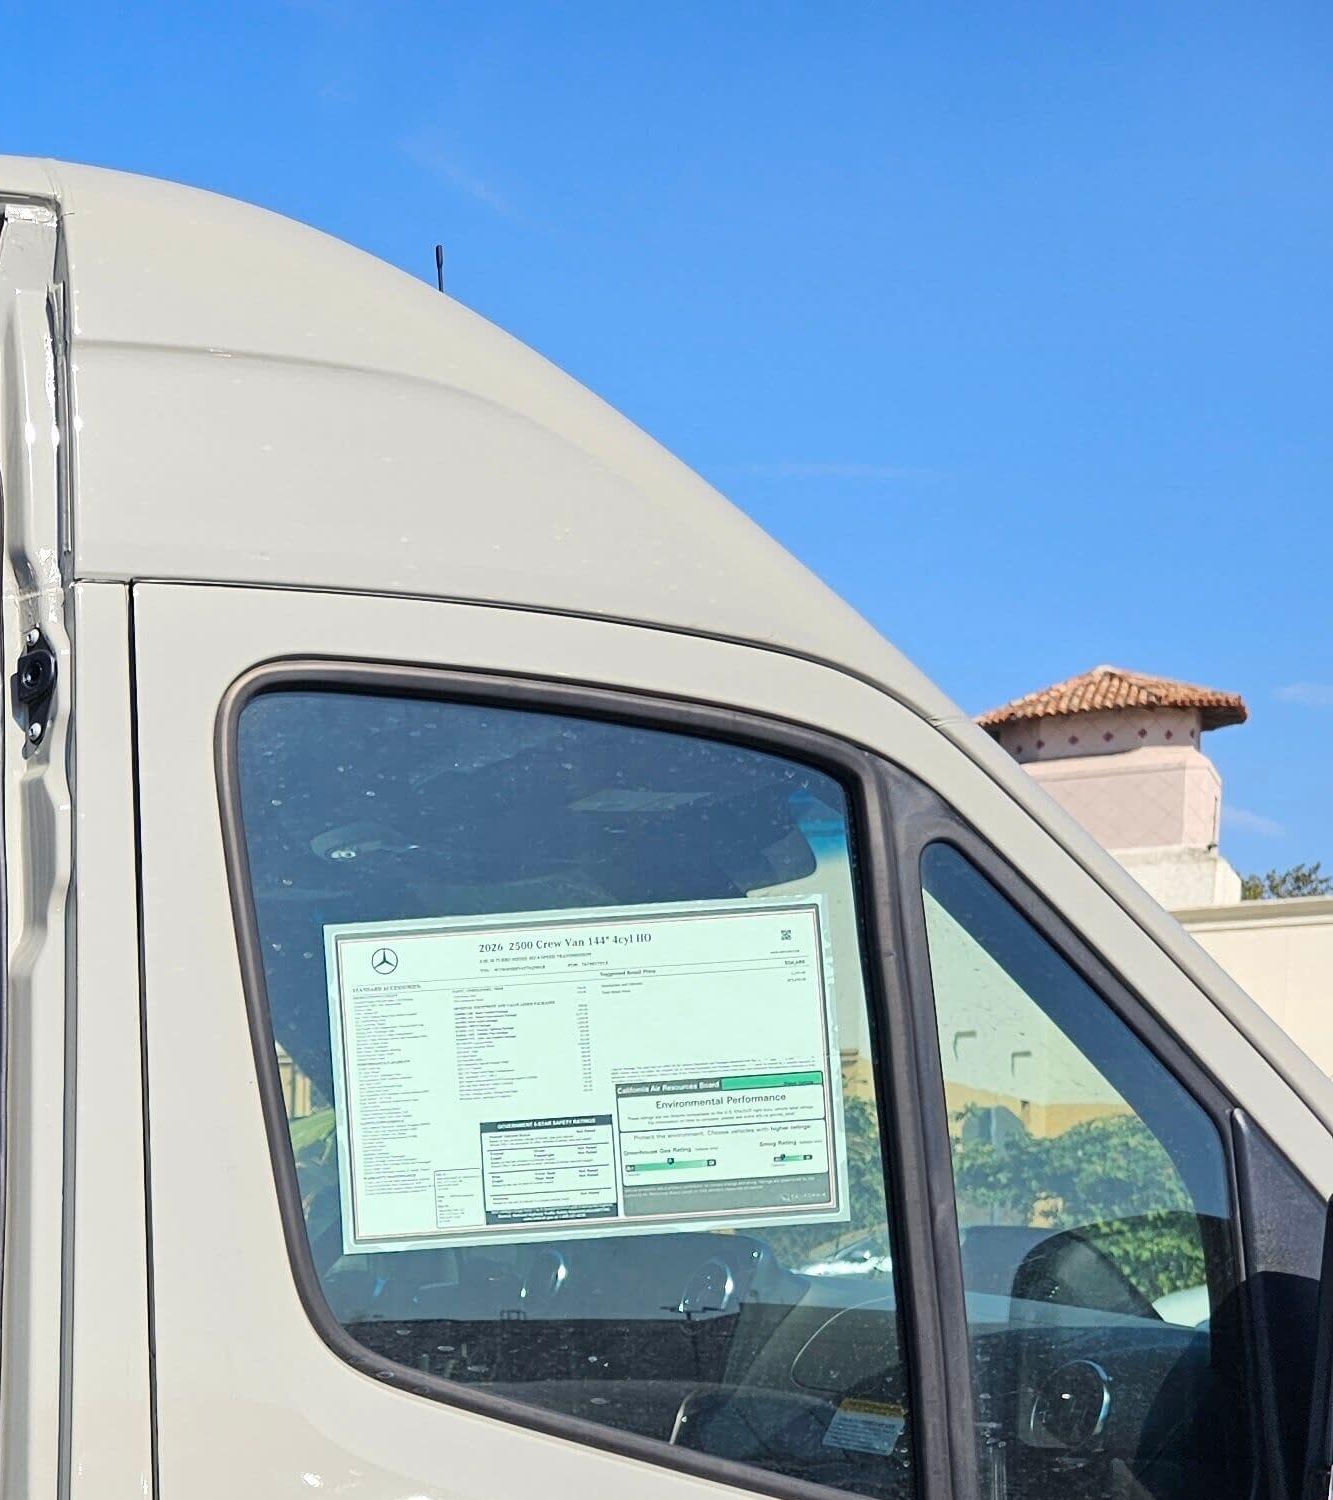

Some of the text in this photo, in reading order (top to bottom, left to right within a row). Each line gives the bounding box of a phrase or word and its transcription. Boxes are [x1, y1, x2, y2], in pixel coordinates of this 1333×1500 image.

[479, 943, 503, 953] 2026
[509, 941, 533, 951] 2500
[536, 940, 561, 949] Crew
[565, 938, 585, 947] Van
[612, 934, 633, 945] 4cyl
[699, 1081, 720, 1089] Board
[655, 1094, 787, 1109] Environmental Performance
